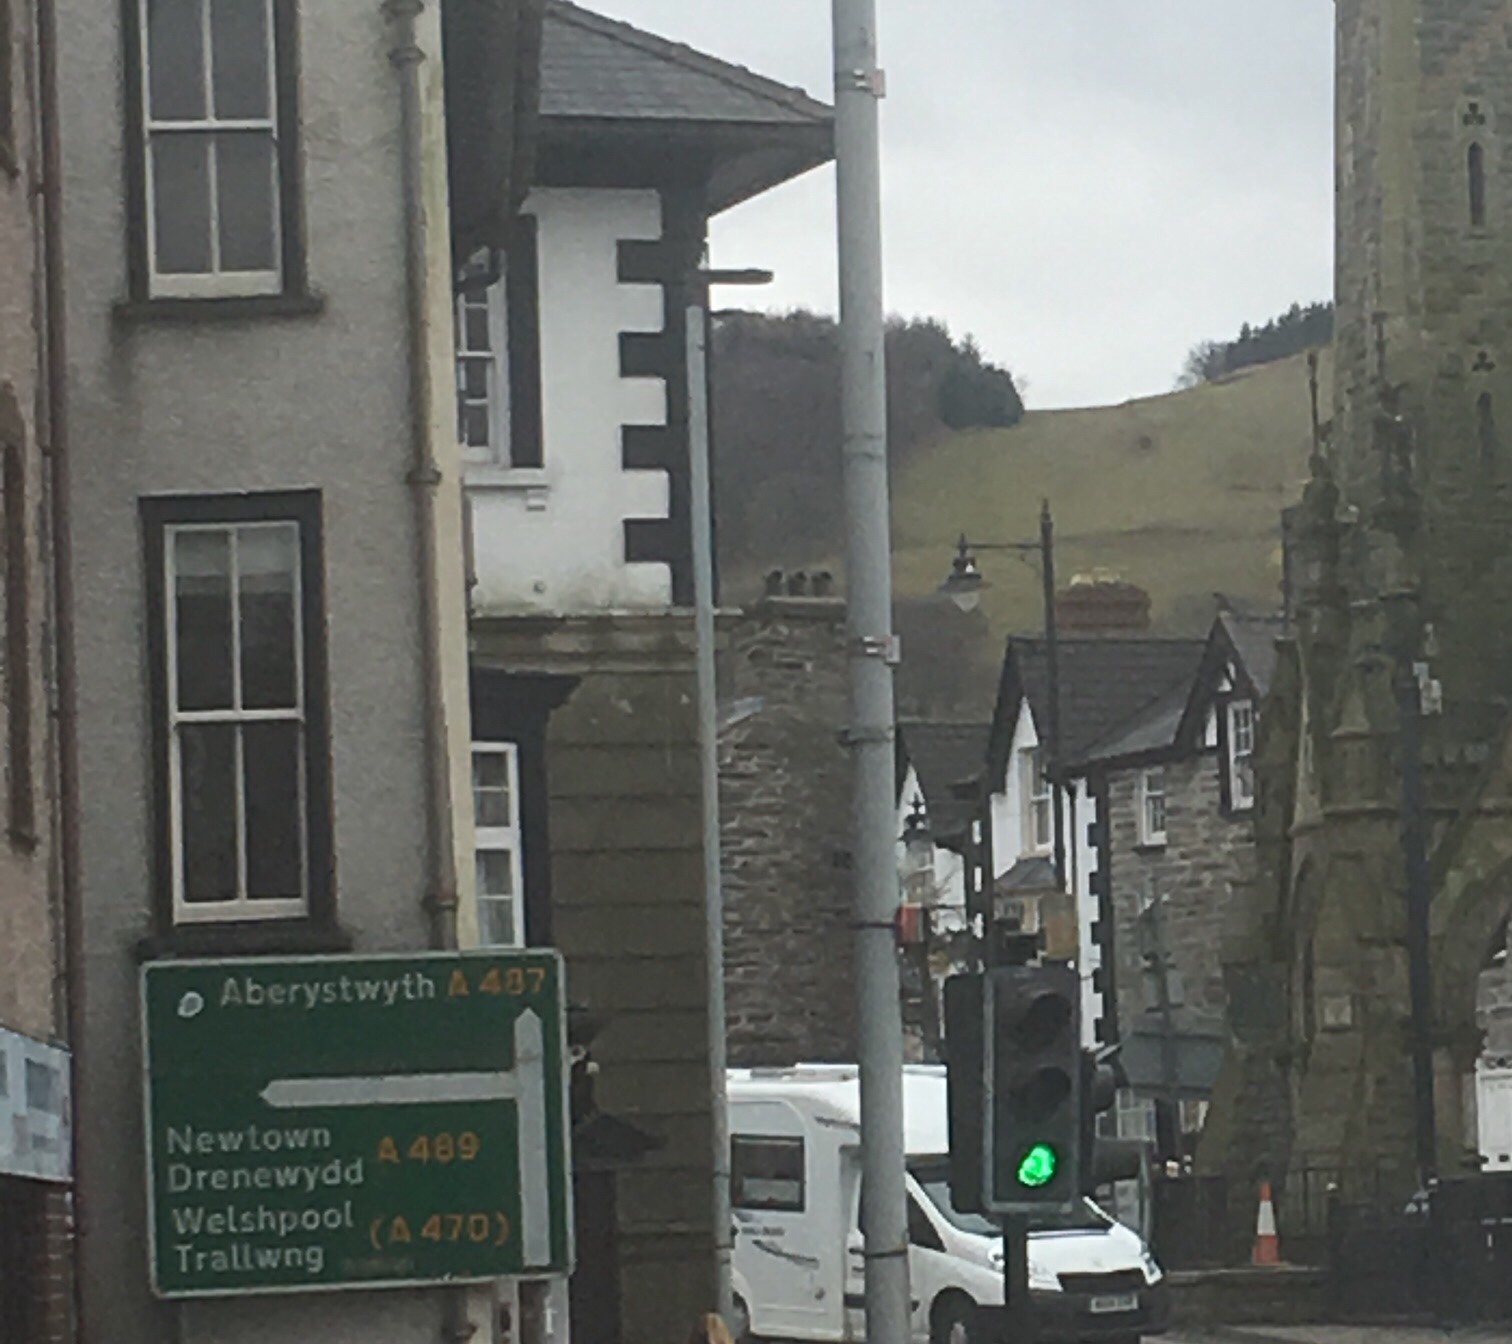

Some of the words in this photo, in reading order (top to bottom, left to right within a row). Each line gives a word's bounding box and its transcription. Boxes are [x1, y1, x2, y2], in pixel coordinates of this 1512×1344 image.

[220, 972, 435, 1009] Aberystwyth
[166, 1125, 332, 1155] Newtown
[168, 1158, 365, 1193] Drenewydd
[171, 1201, 355, 1235] Welshpool
[173, 1244, 325, 1276] Trallwng
